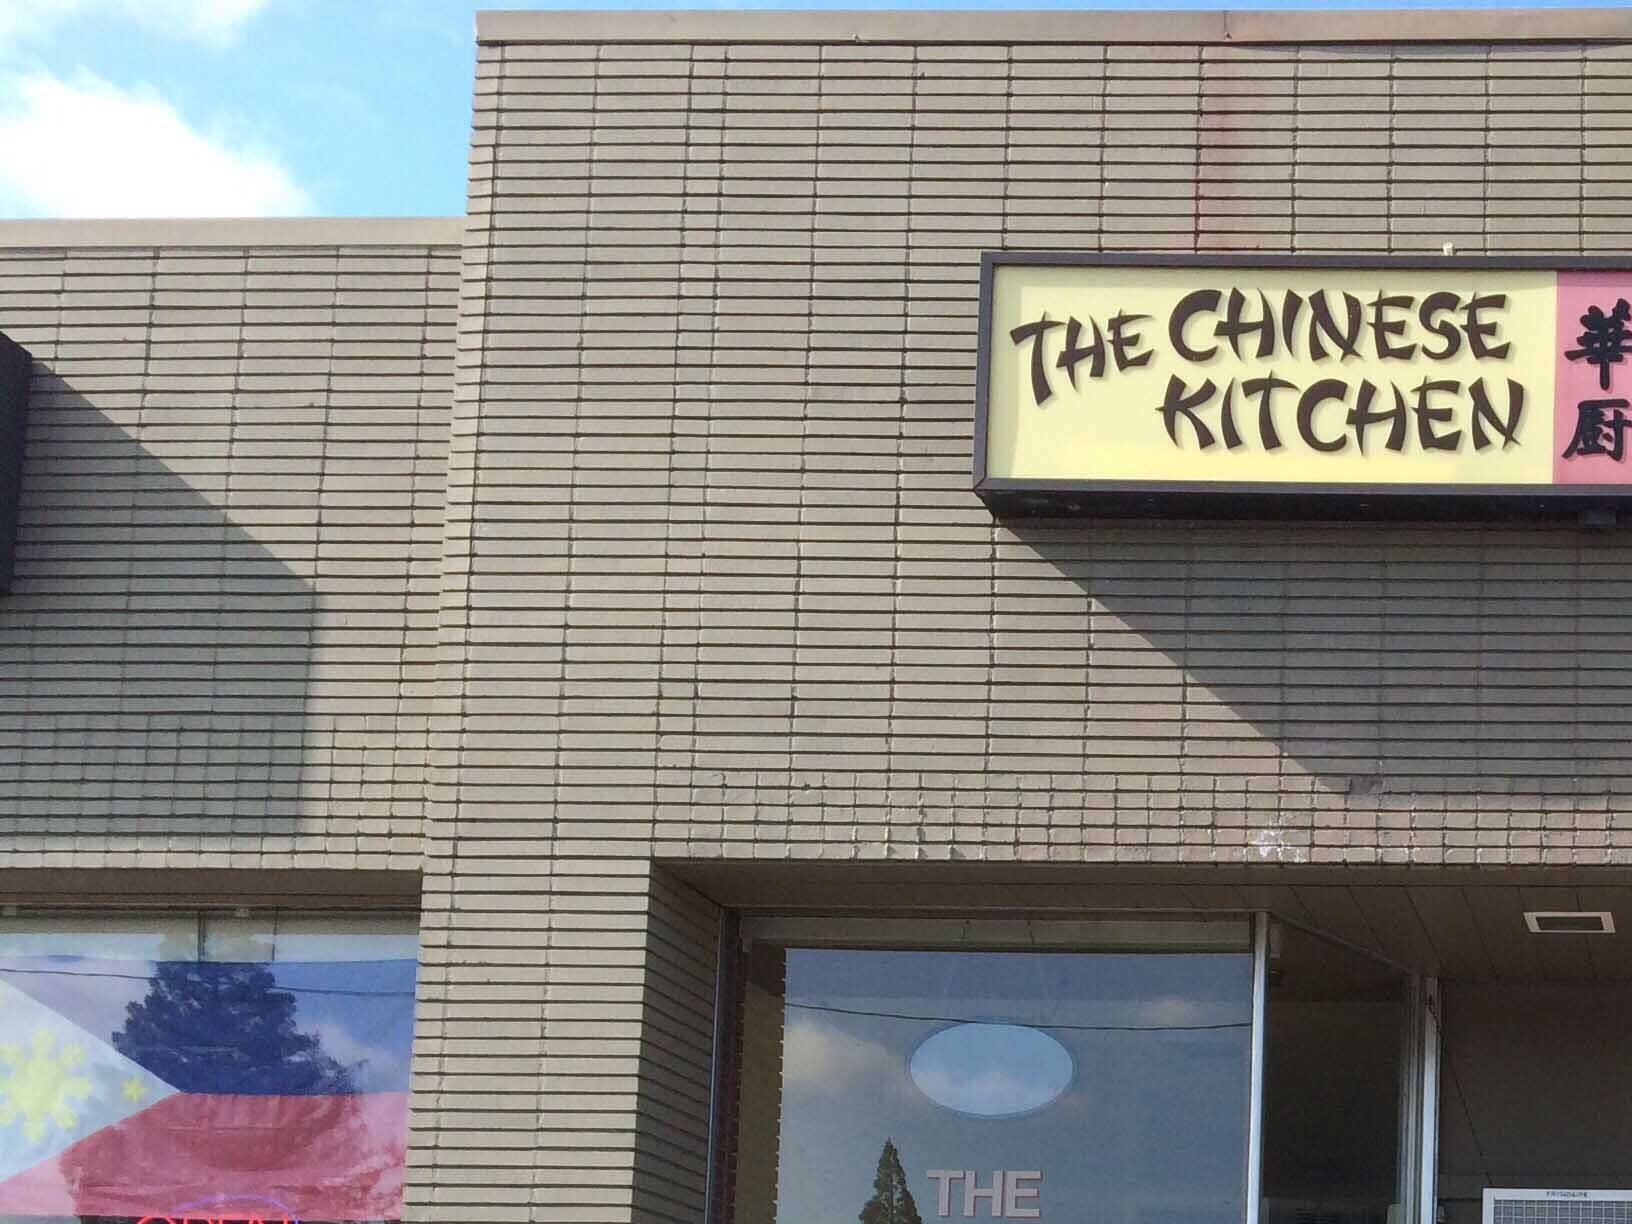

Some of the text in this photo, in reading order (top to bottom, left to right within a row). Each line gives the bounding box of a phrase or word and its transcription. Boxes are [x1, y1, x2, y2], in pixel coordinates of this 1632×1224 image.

[1010, 286, 1511, 406] THE CHINESE
[1155, 370, 1525, 456] KITCHEN
[927, 1169, 1042, 1218] THE
